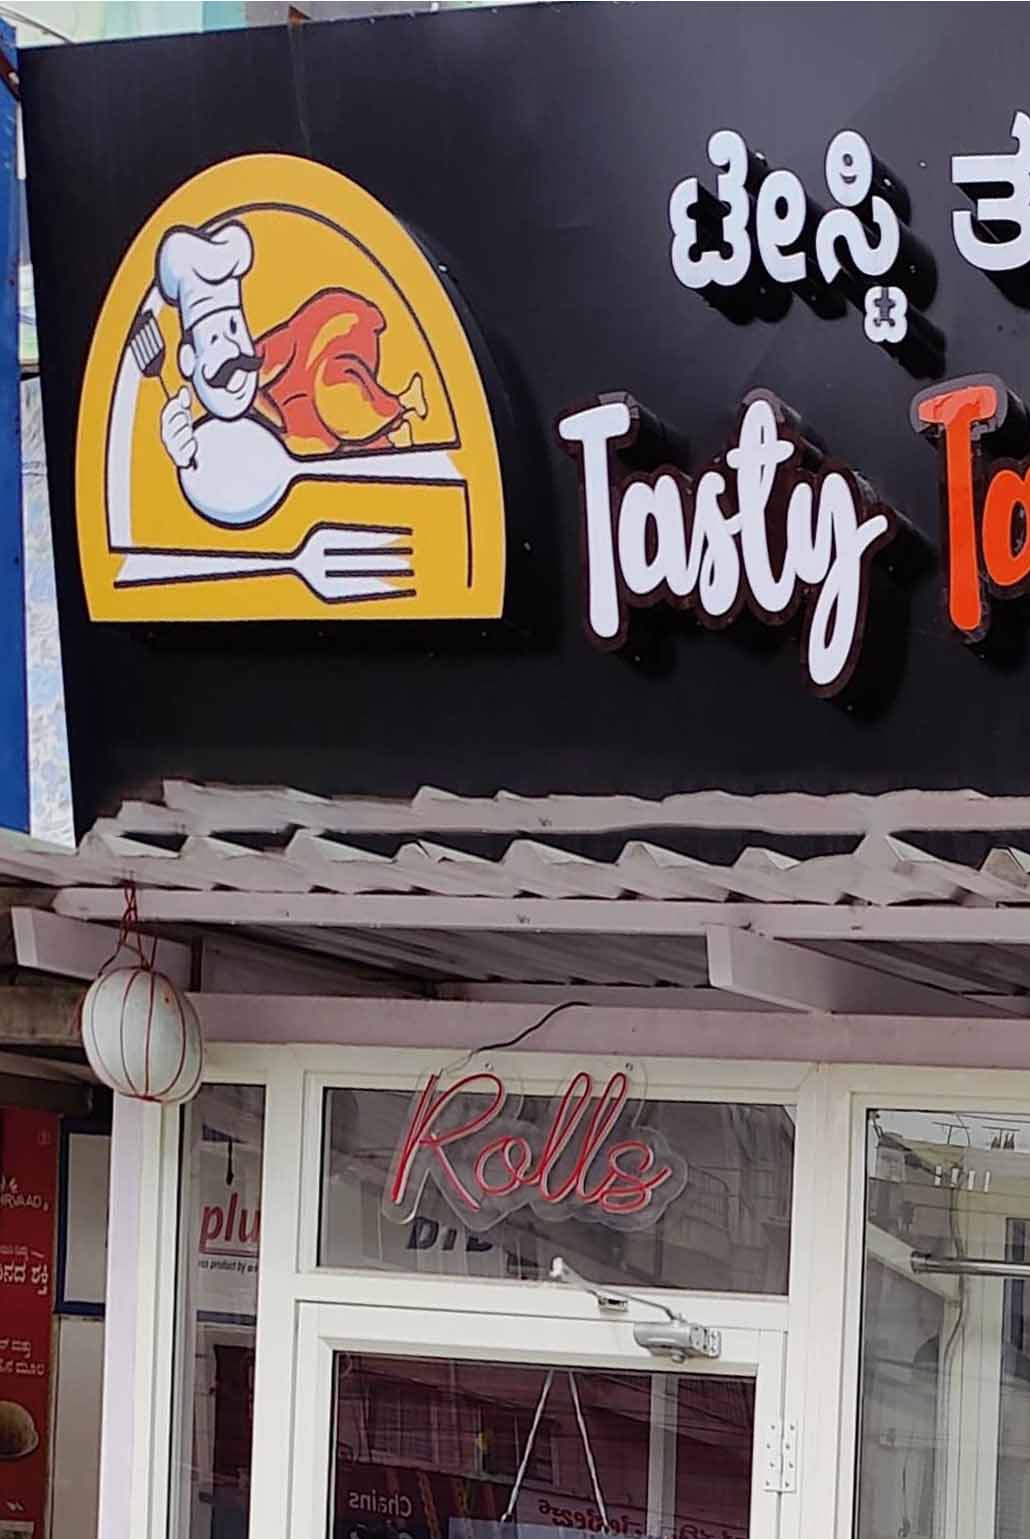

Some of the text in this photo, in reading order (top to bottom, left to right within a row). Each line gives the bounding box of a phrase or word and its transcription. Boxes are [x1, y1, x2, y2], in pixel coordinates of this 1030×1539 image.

[669, 130, 908, 343] ಟೇಸ್ಟಿ
[558, 402, 889, 685] Tasty
[391, 1072, 672, 1213] Rolls
